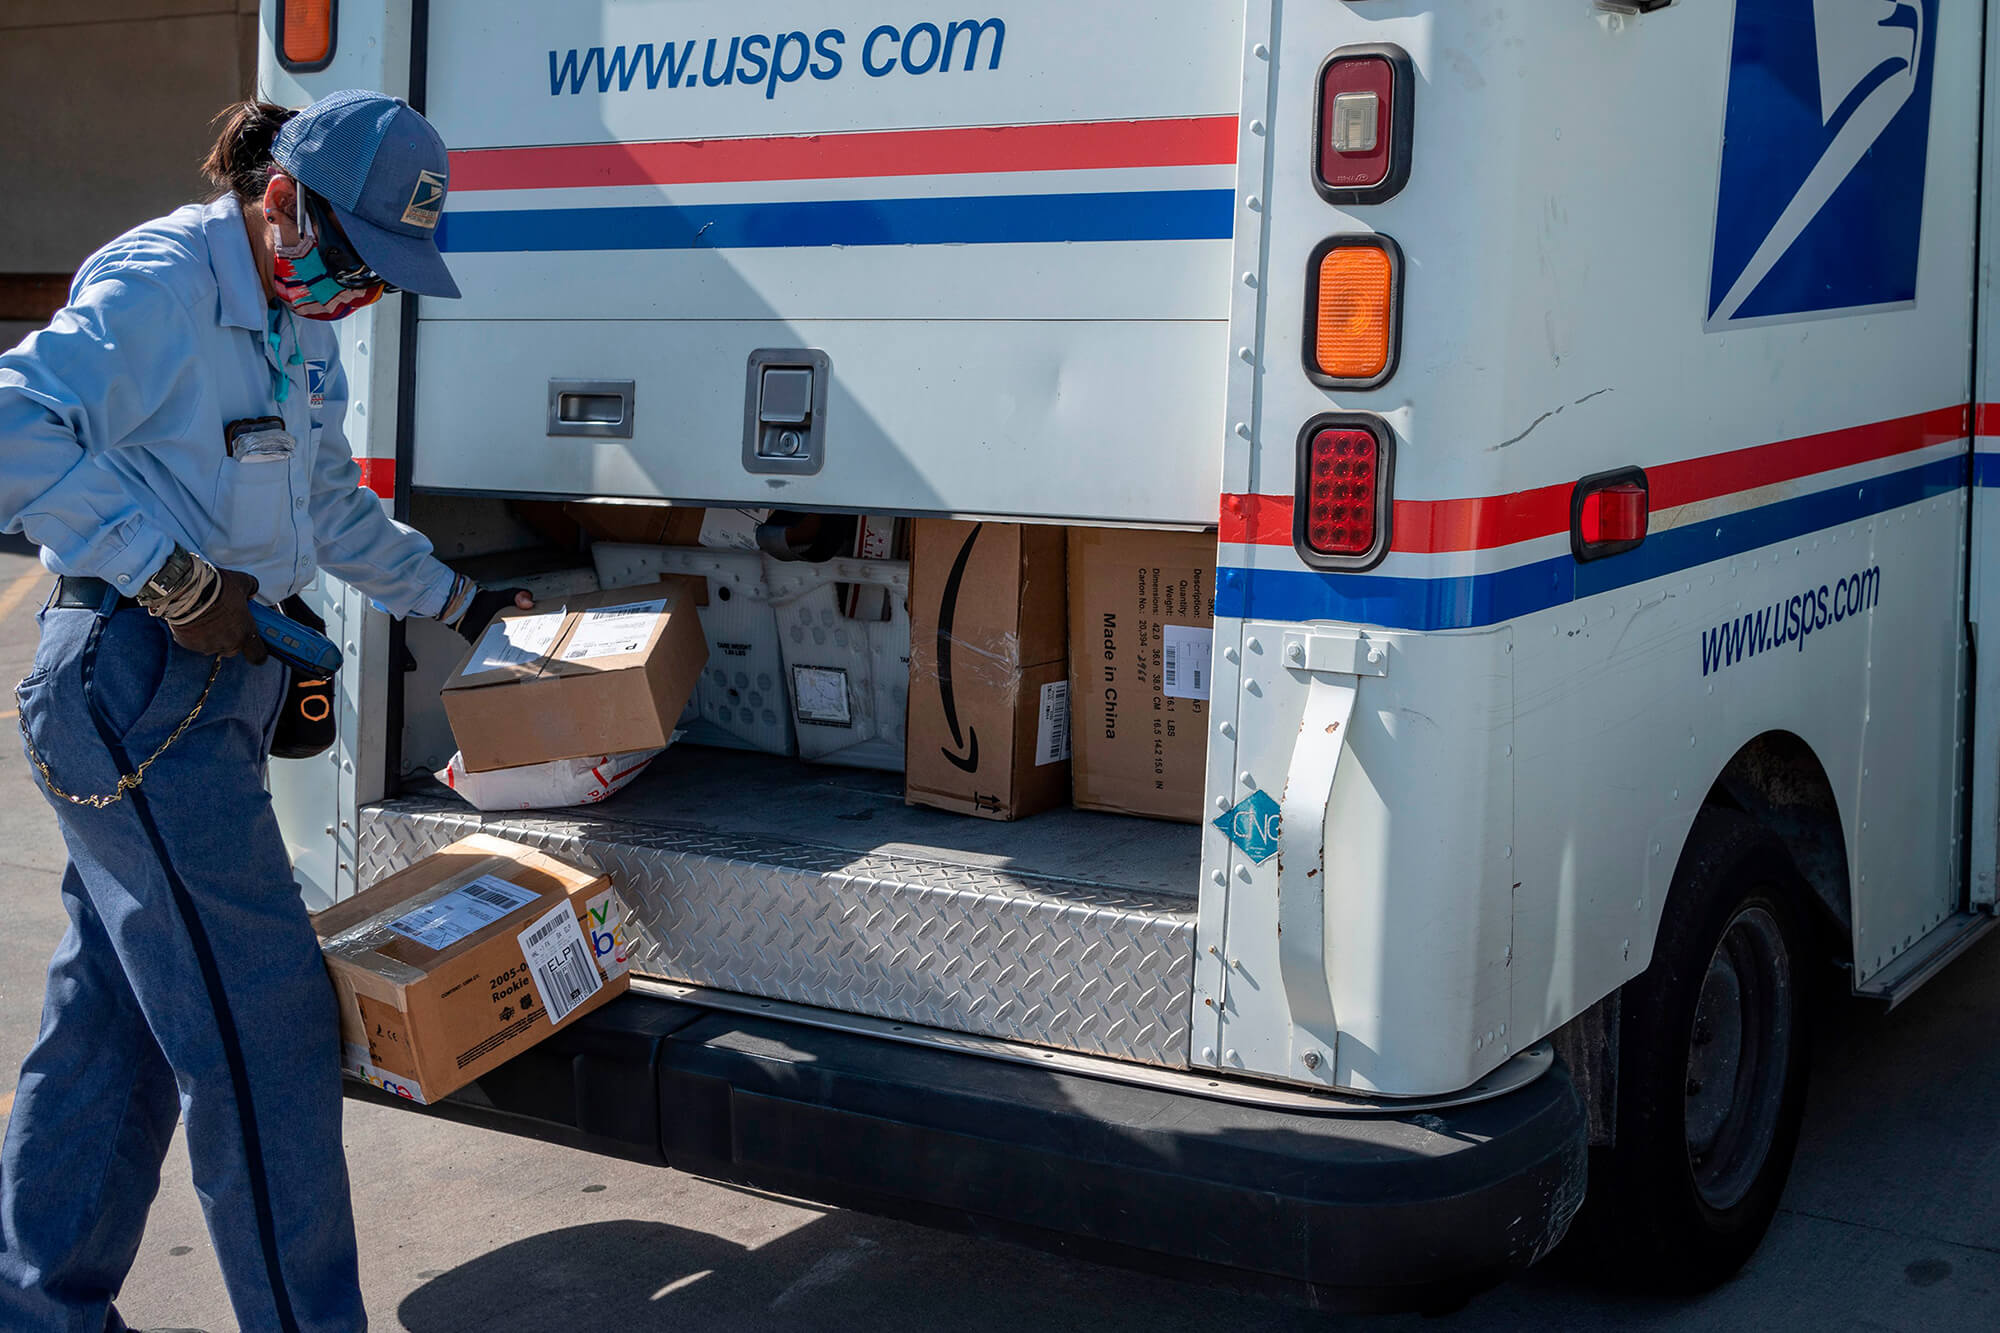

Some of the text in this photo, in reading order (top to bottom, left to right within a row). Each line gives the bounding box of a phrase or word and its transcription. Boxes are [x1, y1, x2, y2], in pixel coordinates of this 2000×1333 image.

[862, 17, 1006, 78] com
[1138, 568, 1147, 597] Carton
[1152, 568, 1160, 616] Dimensions:
[1192, 568, 1202, 618] Description:
[1164, 585, 1174, 617] Weight:
[1178, 580, 1188, 617] Quantity:
[1152, 623, 1160, 640] 42.0
[1702, 566, 1881, 677] www.usps.com
[1103, 613, 1118, 739] Made in China
[1152, 696, 1161, 710] CM
[1167, 720, 1176, 737] LBS
[547, 947, 571, 972] ELP
[489, 962, 530, 990] 2005-0
[491, 977, 529, 1003] Rookie
